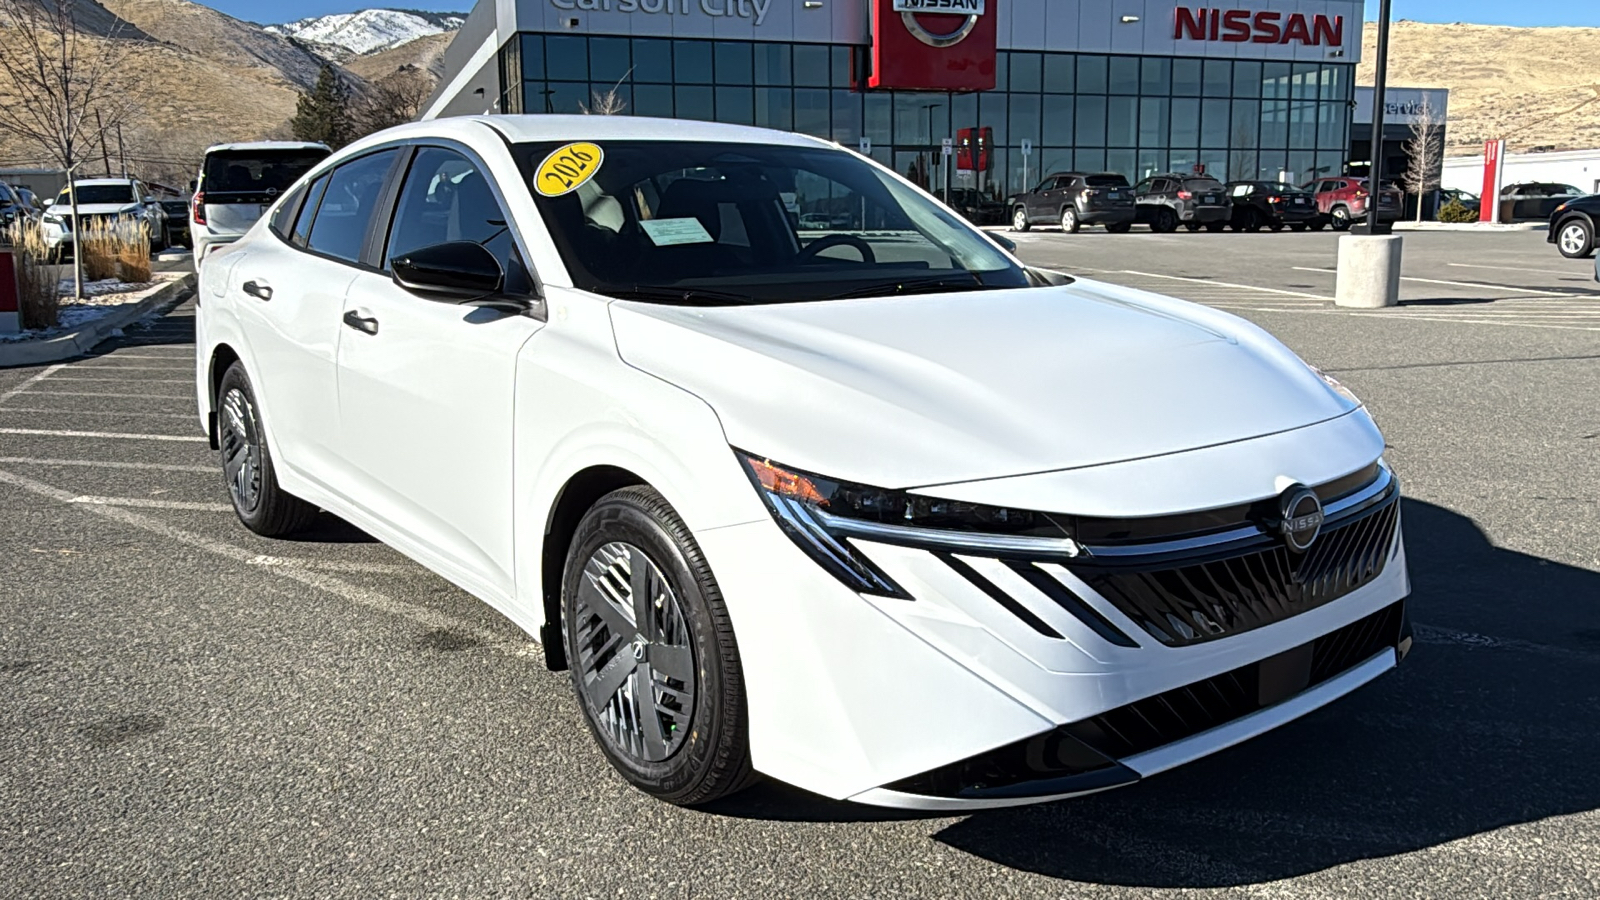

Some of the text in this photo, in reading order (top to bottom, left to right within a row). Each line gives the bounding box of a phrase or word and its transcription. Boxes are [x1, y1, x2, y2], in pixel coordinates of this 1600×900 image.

[701, 0, 771, 26] City
[904, 0, 978, 10] NISSAN
[1174, 7, 1343, 46] NISSAN
[545, 147, 593, 188] 2026
